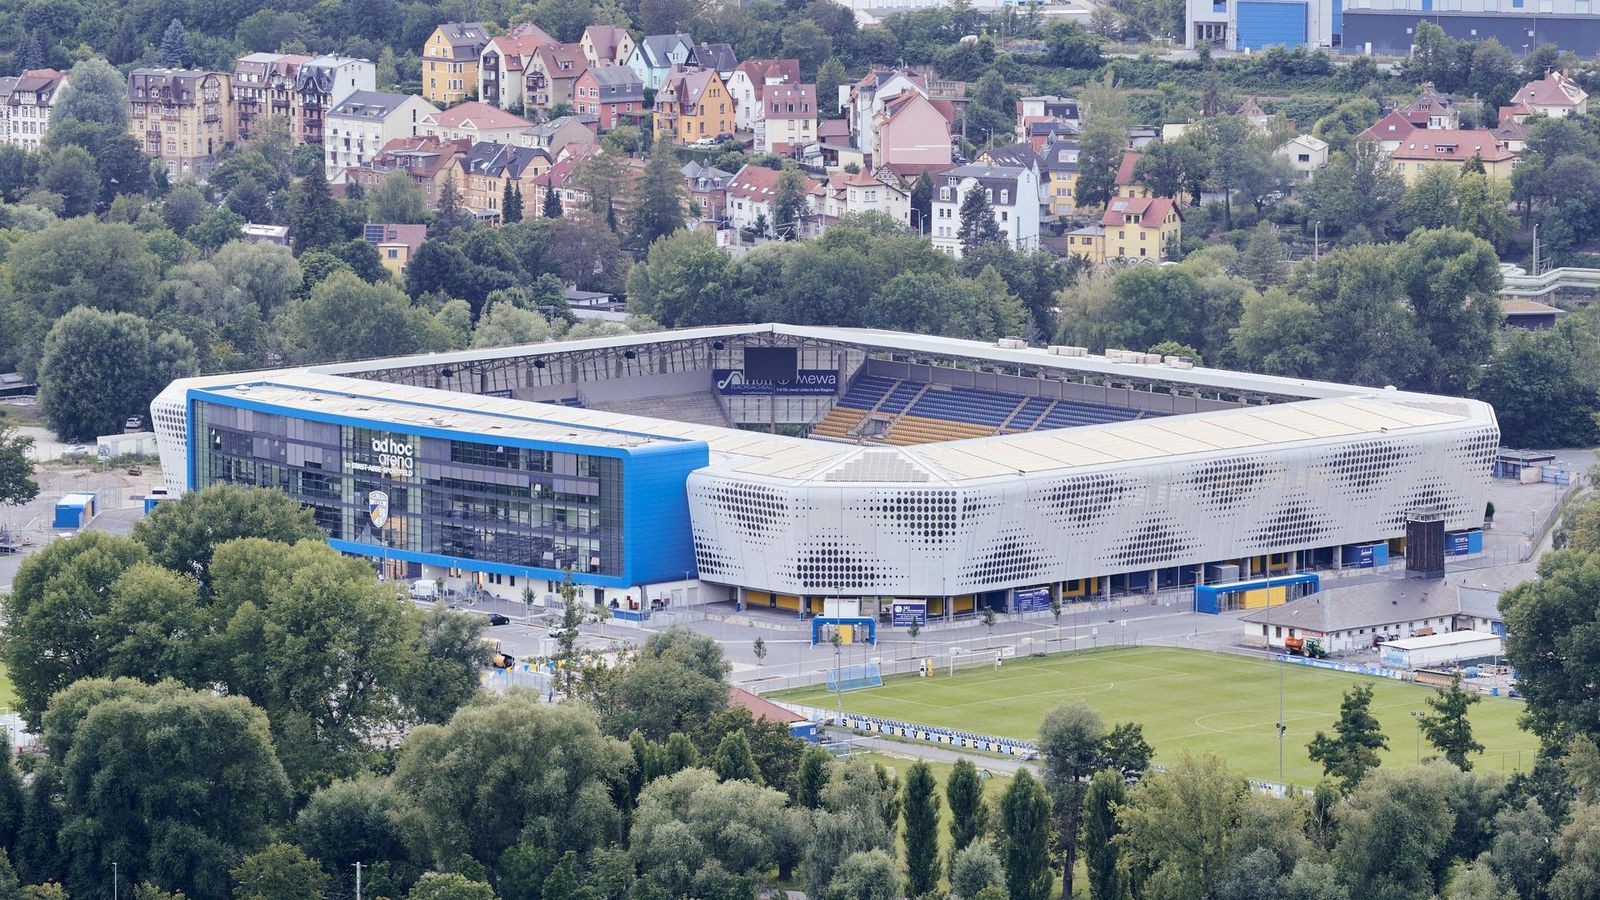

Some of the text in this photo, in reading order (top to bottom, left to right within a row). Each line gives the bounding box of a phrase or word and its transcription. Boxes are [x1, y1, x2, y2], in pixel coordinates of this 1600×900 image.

[796, 375, 836, 384] mewa
[372, 438, 413, 456] ad hoc
[378, 453, 413, 469] arena
